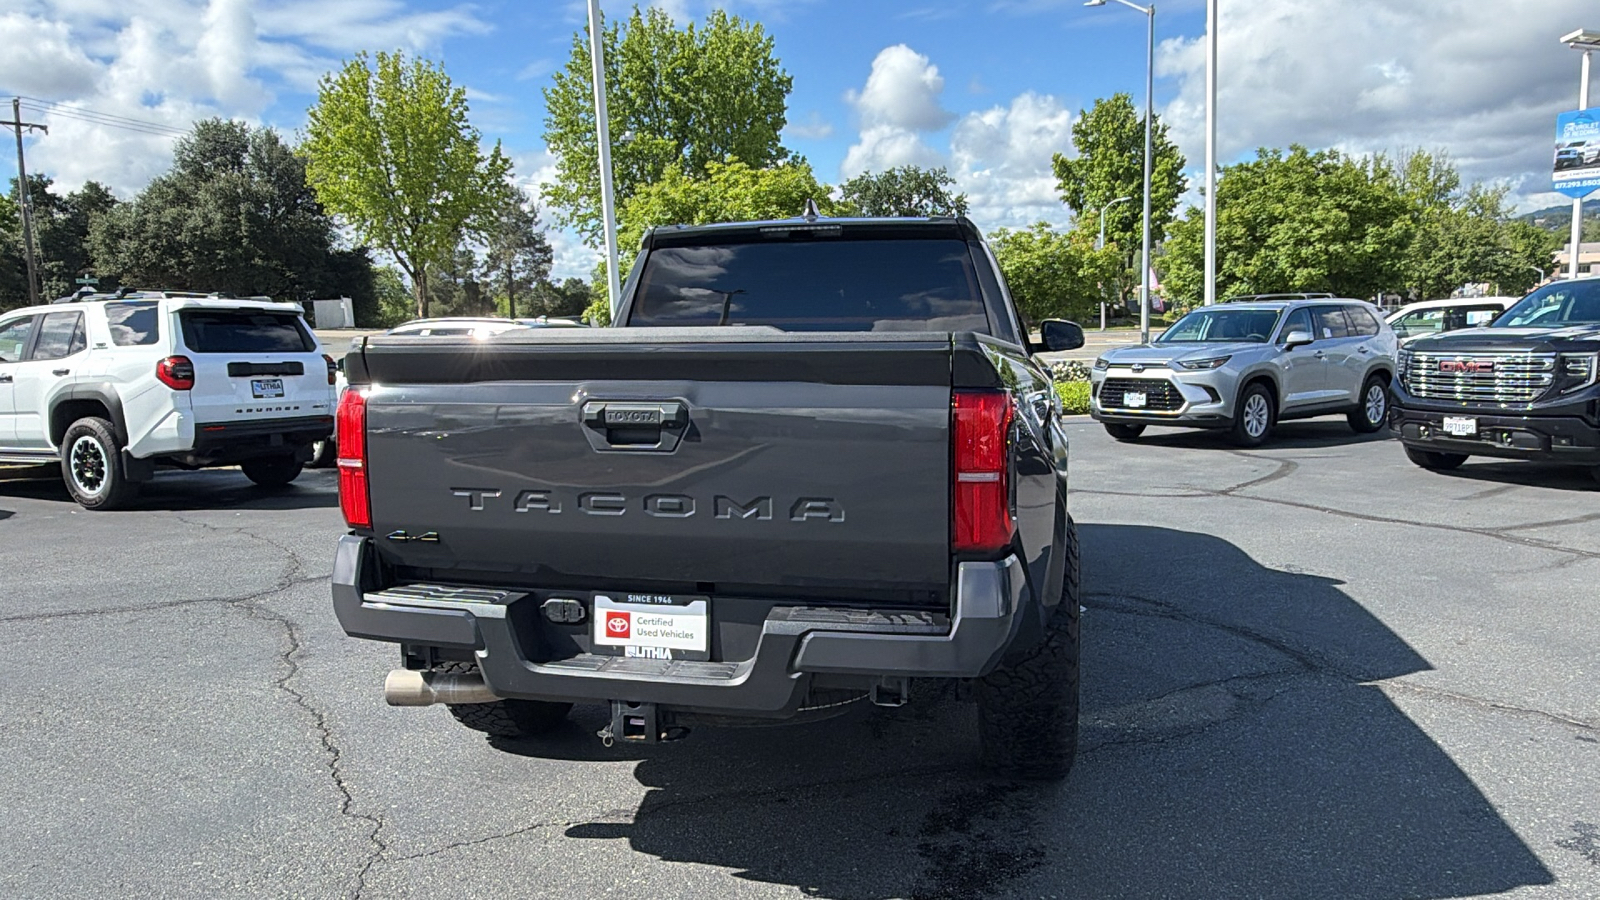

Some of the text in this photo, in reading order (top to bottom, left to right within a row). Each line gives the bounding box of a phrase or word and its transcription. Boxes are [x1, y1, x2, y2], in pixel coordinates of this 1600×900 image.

[1440, 361, 1493, 372] GMC
[607, 411, 656, 422] TOYOTA
[450, 487, 845, 522] TACOMA
[627, 594, 672, 604] SINCE 1946
[636, 617, 674, 627] Certified
[637, 628, 694, 640] Used Vehicles
[635, 646, 673, 660] LITHIA
